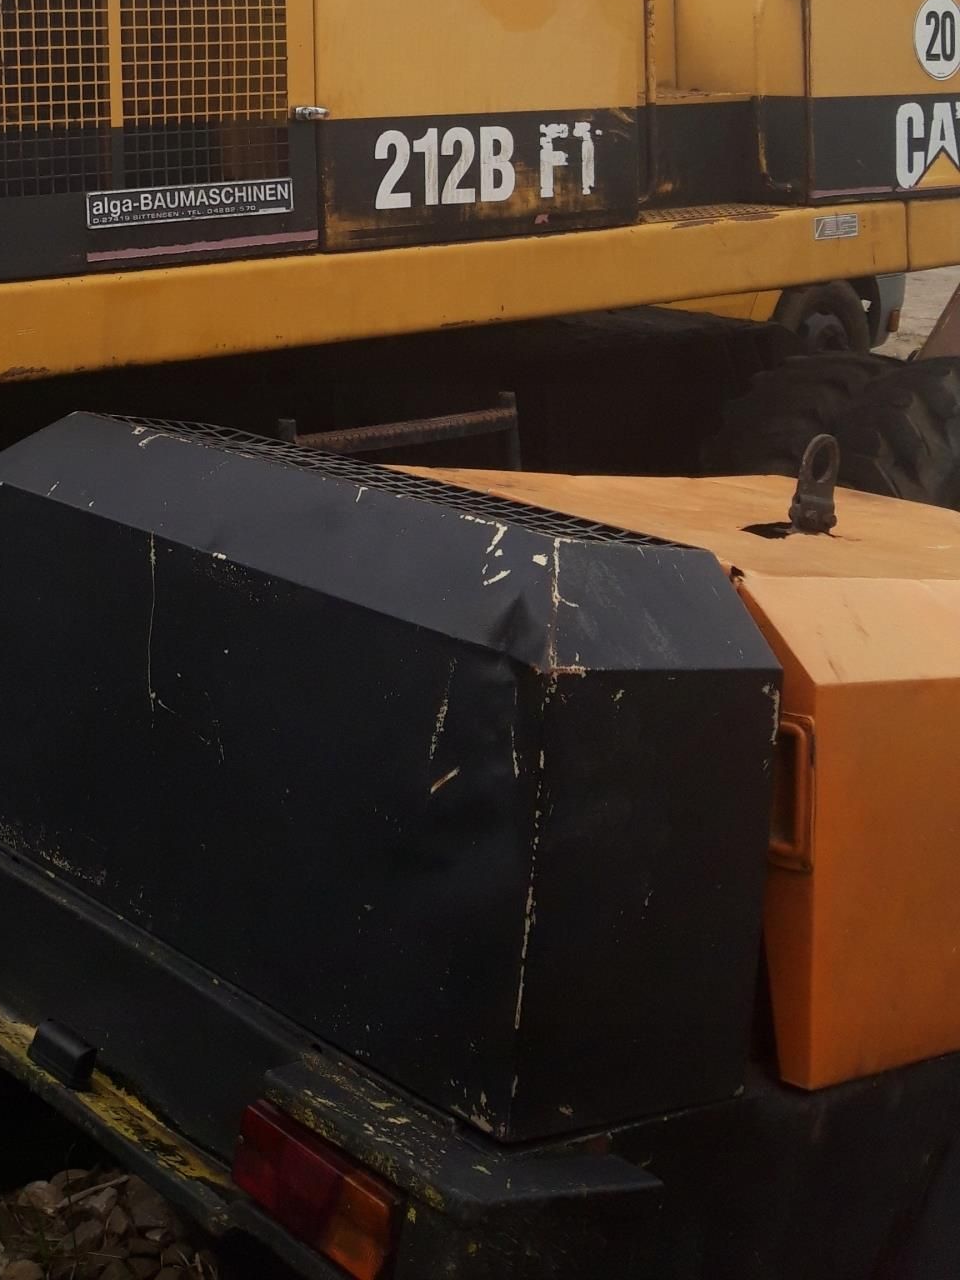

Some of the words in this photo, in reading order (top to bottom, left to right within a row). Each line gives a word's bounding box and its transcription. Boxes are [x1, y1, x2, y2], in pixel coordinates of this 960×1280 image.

[925, 10, 956, 62] 20
[374, 126, 516, 210] 212B
[896, 101, 960, 189] CA
[92, 183, 289, 217] alga-BAUMASCHINEN
